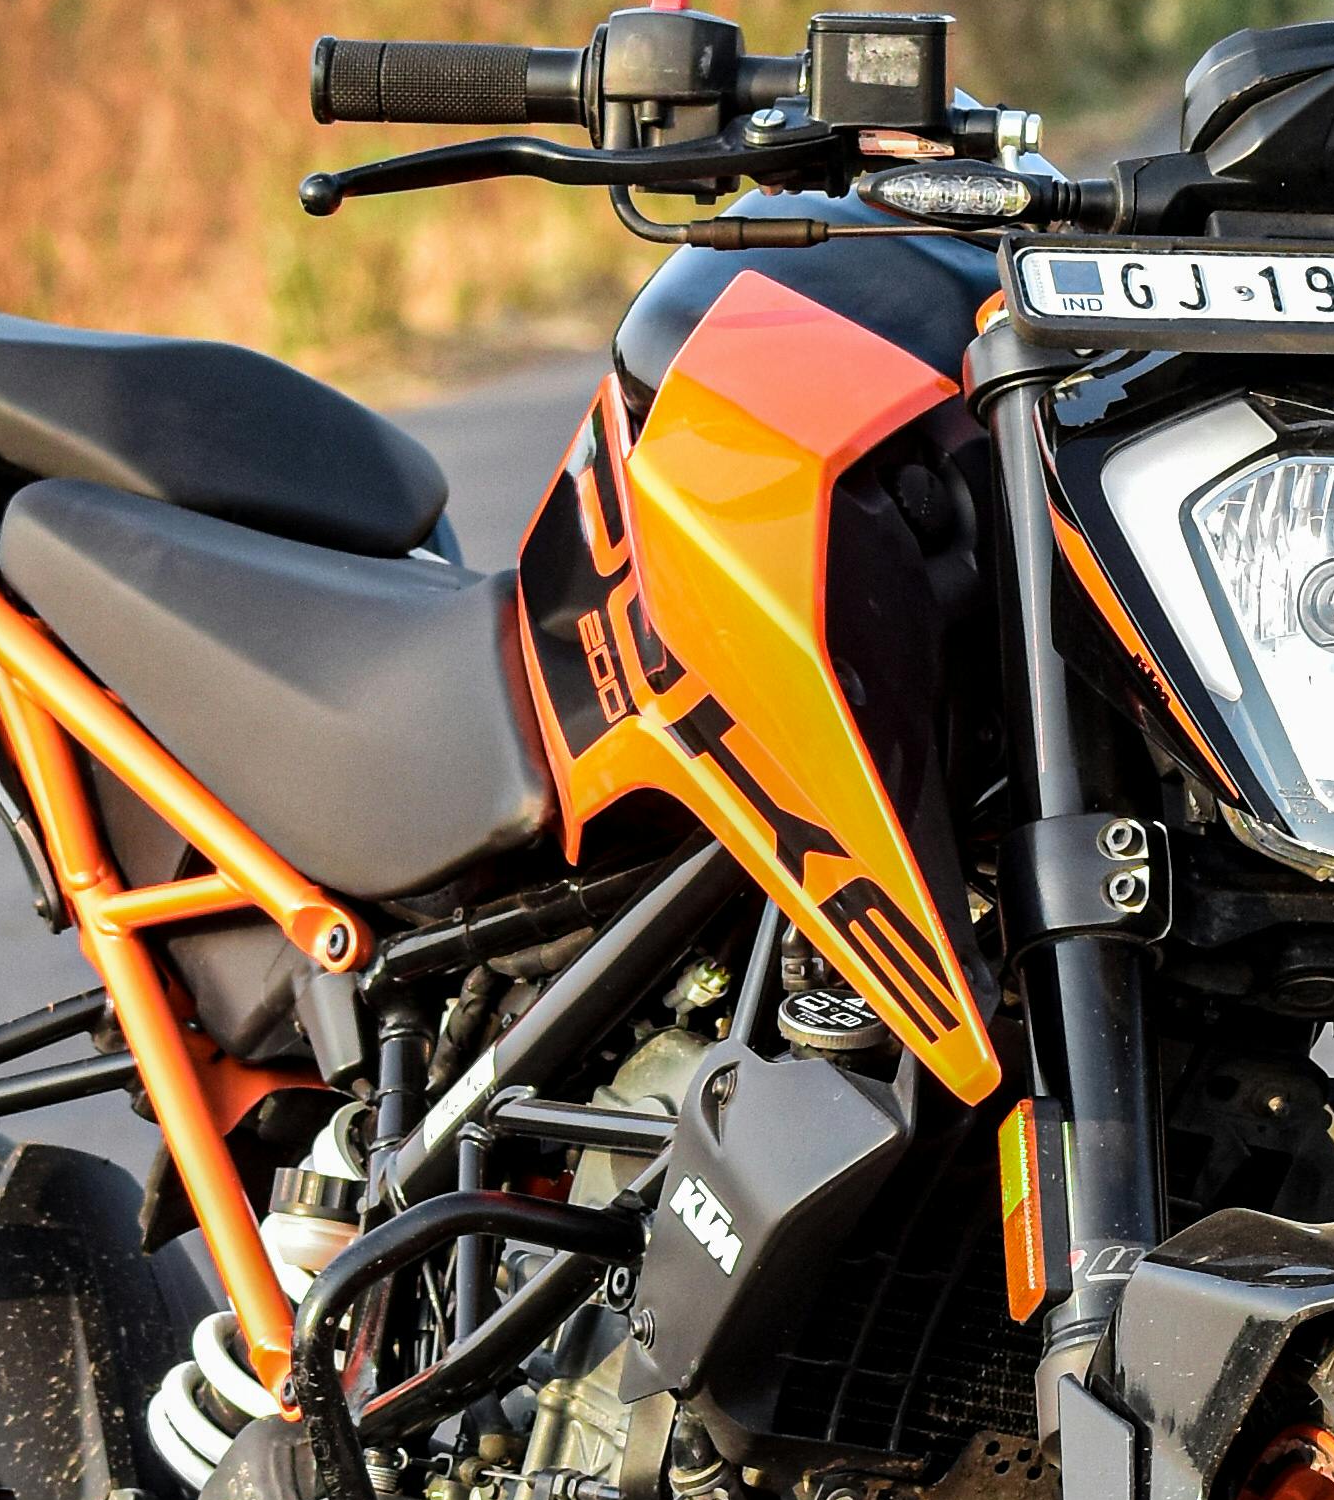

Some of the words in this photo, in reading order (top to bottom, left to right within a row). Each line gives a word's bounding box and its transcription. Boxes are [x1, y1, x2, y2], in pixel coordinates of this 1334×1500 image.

[1062, 298, 1103, 312] IND
[1120, 262, 1207, 311] GJ
[577, 609, 628, 724] 200
[669, 1176, 743, 1276] KTM
